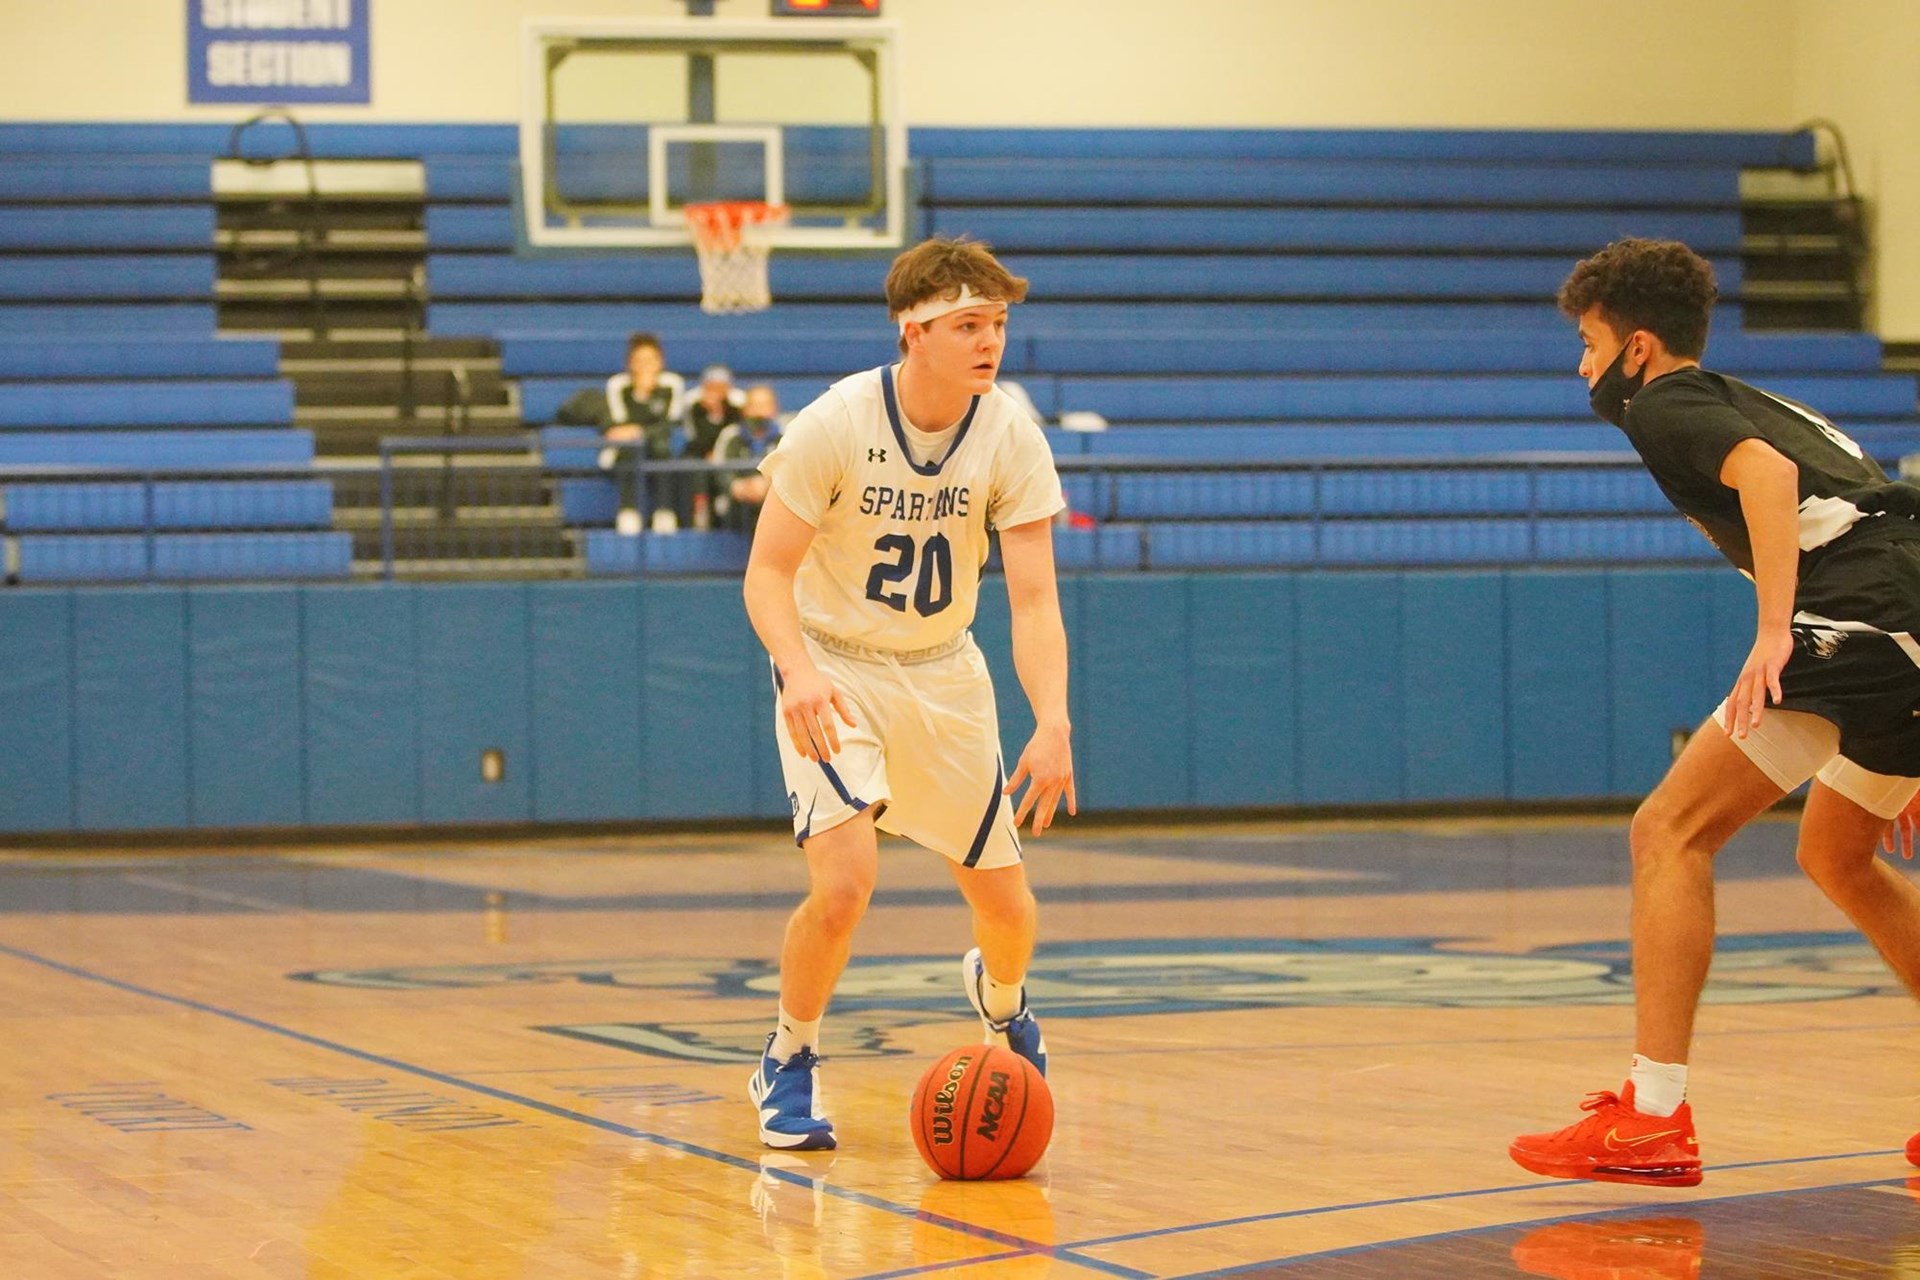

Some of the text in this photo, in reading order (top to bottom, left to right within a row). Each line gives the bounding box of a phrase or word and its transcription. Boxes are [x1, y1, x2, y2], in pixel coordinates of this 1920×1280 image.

[206, 41, 352, 87] SECTION
[865, 531, 953, 618] 20
[932, 1055, 973, 1146] Wilson
[976, 1071, 1010, 1142] NCAA
